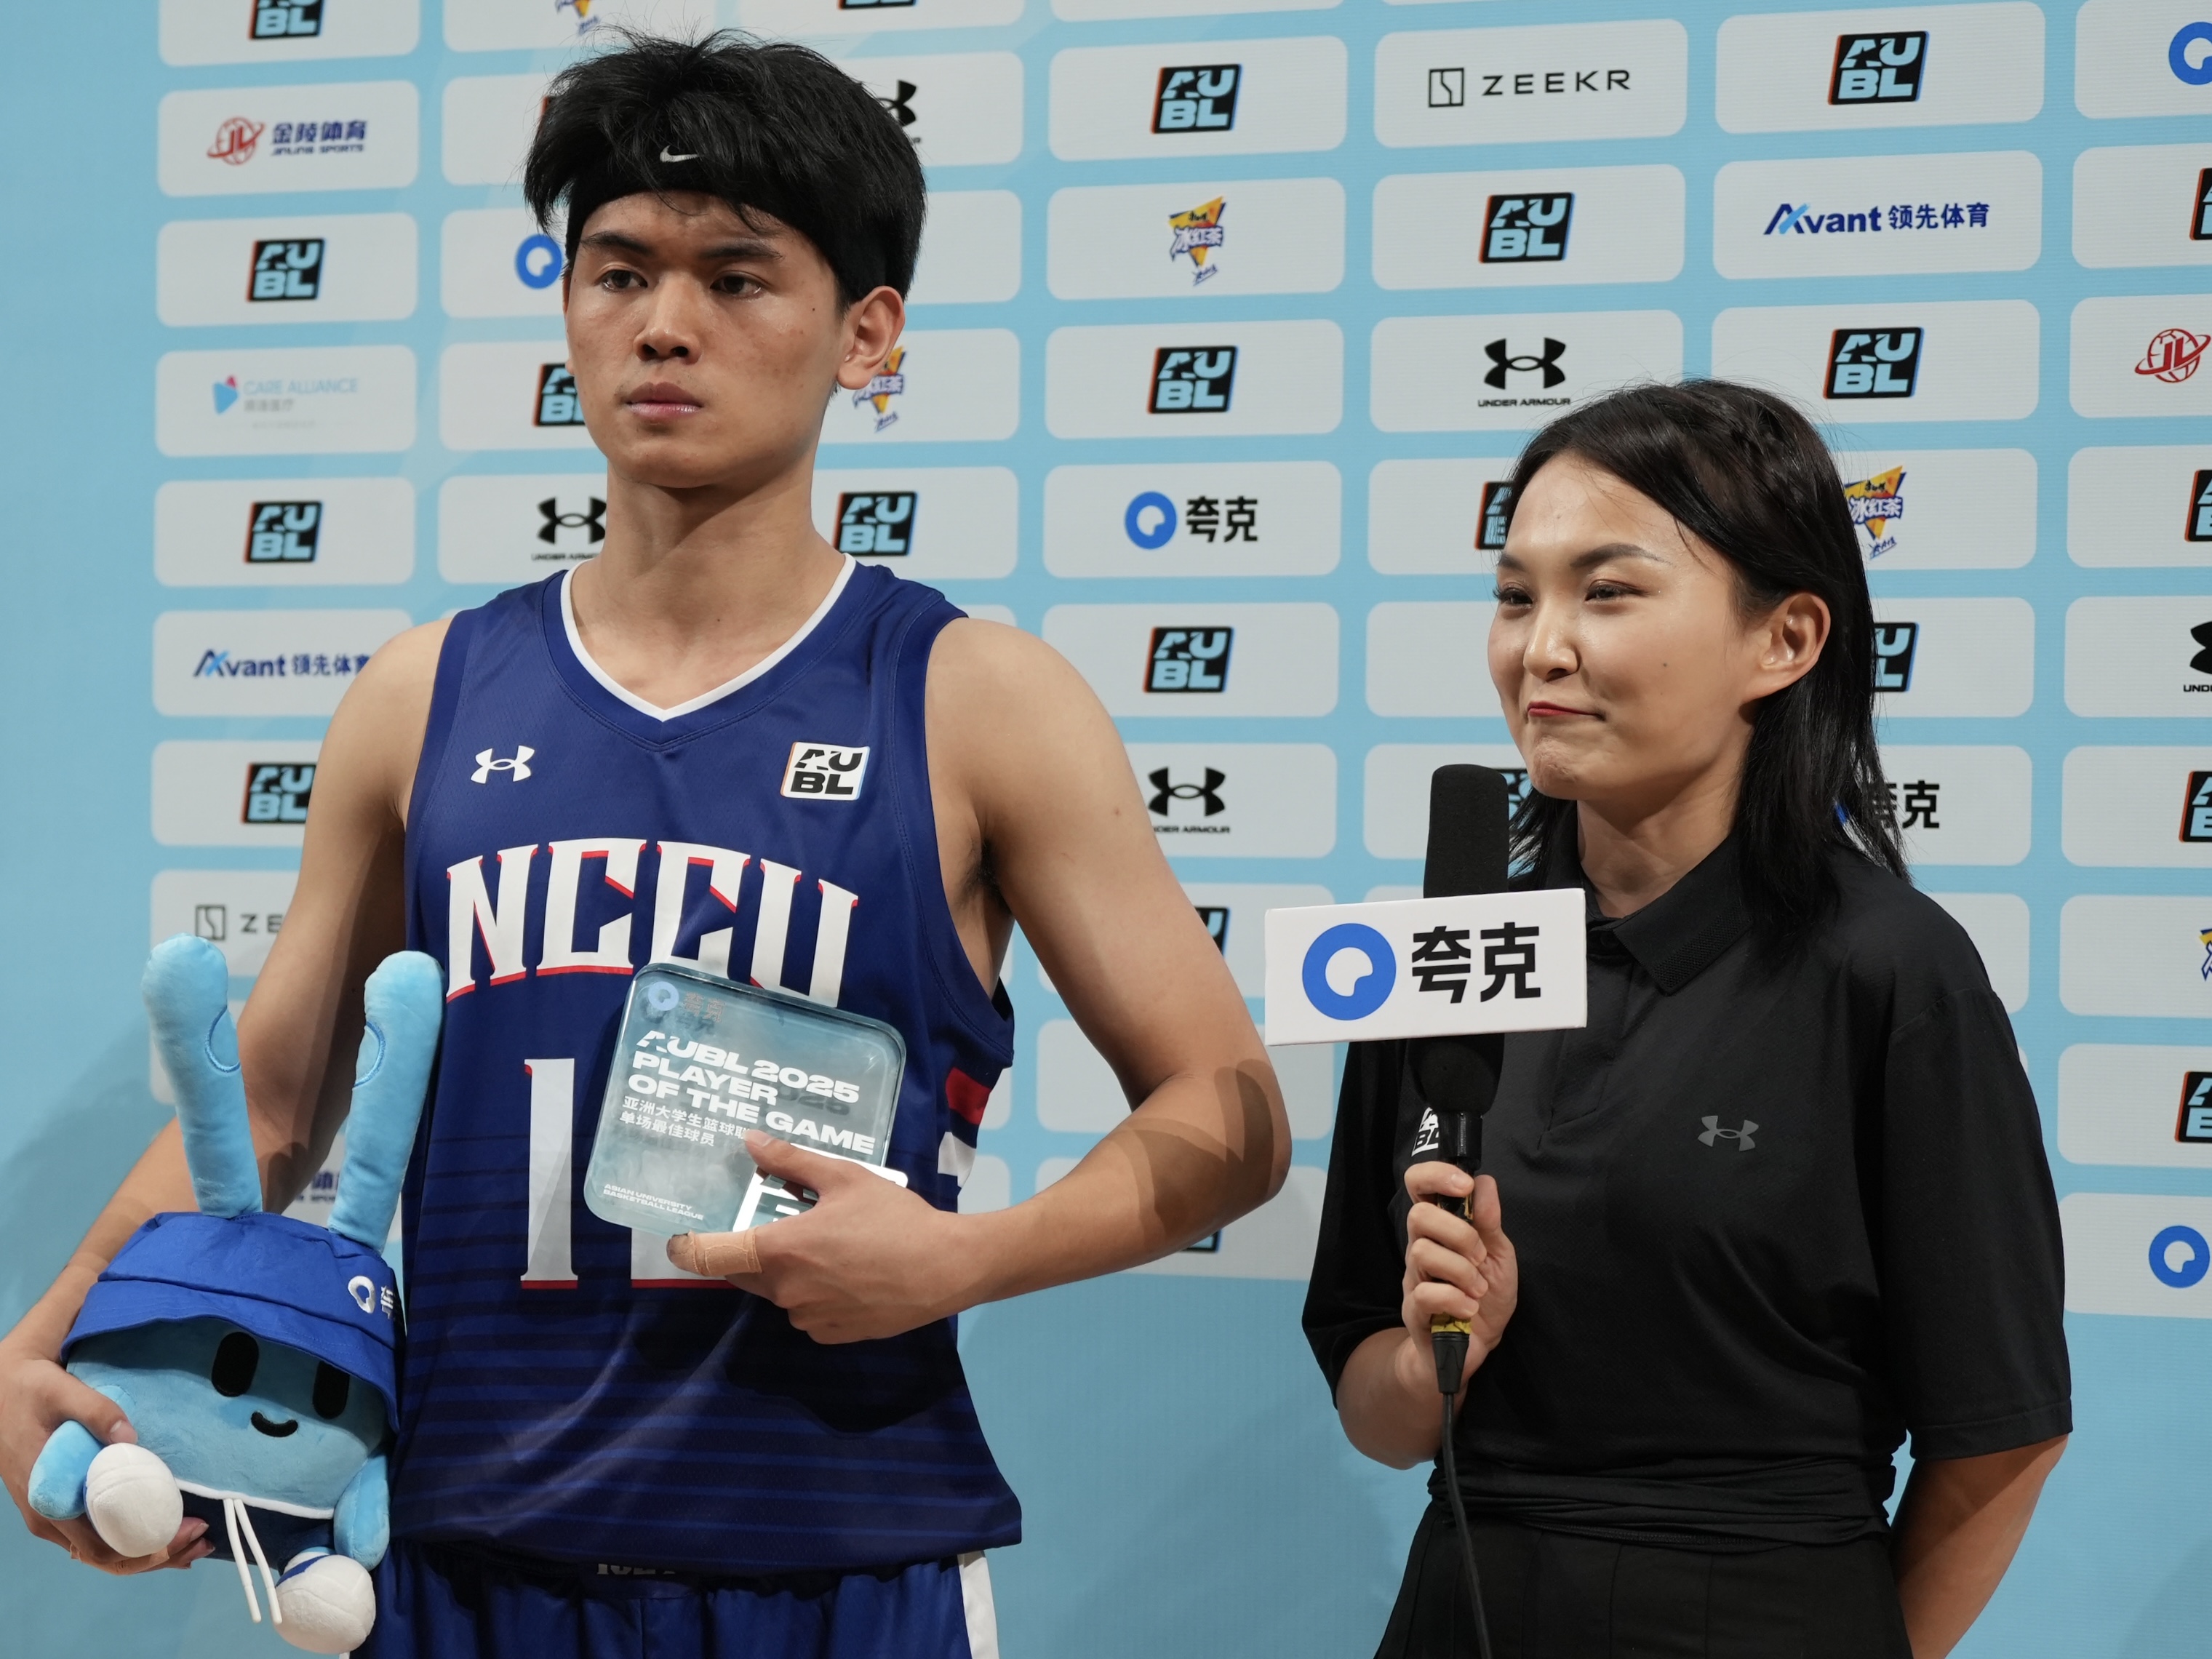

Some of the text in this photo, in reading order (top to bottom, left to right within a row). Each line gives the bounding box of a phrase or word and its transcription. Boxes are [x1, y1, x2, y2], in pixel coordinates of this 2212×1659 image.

[255, 7, 317, 36] BL
[1840, 37, 1920, 68] AU
[1161, 69, 1234, 99] AU
[1482, 70, 1631, 96] ZEEKR
[1838, 68, 1913, 99] BL
[1159, 99, 1228, 128] BL
[273, 121, 366, 144] 金陵体育
[320, 145, 364, 153] SPORTS
[1490, 198, 1567, 228] AU
[1763, 202, 1990, 235] Avant 领先体育
[255, 243, 320, 270] AU
[1488, 228, 1560, 257] BL
[253, 270, 314, 298] BL
[1835, 333, 1915, 362] AU
[1157, 351, 1231, 378] AU
[1833, 364, 1908, 393] BL
[244, 377, 358, 396] CARE ALLIANCE
[1156, 380, 1224, 408] BL
[1478, 397, 1570, 407] UNDER ARMOUR
[252, 505, 316, 532] AU
[841, 497, 911, 524] AU
[1186, 495, 1258, 543] 夸克
[1848, 496, 1903, 524] 冰红茶
[250, 532, 311, 560] BL
[839, 524, 906, 551] BL
[531, 553, 565, 561] UNDER
[1154, 632, 1227, 659] AU
[1875, 628, 1911, 656] U
[194, 649, 285, 677] Avant
[1151, 660, 1221, 689] BL
[1875, 657, 1903, 687] L
[2184, 684, 2212, 692] UND
[794, 748, 863, 772] AU
[791, 771, 854, 795] BL
[1182, 825, 1230, 834] ARMOUR
[446, 837, 859, 1007] NCCU
[1412, 922, 1541, 1004] 夸克
[632, 1050, 778, 1106] PLAYER
[636, 1030, 860, 1103] AUBL 2025
[619, 1111, 715, 1147] 单场最佳球员
[628, 1074, 876, 1156] OF THE GAME
[603, 1188, 704, 1221] BASKETBALL LEAGUE
[604, 1183, 692, 1211] ASIAN UNIVERSITY
